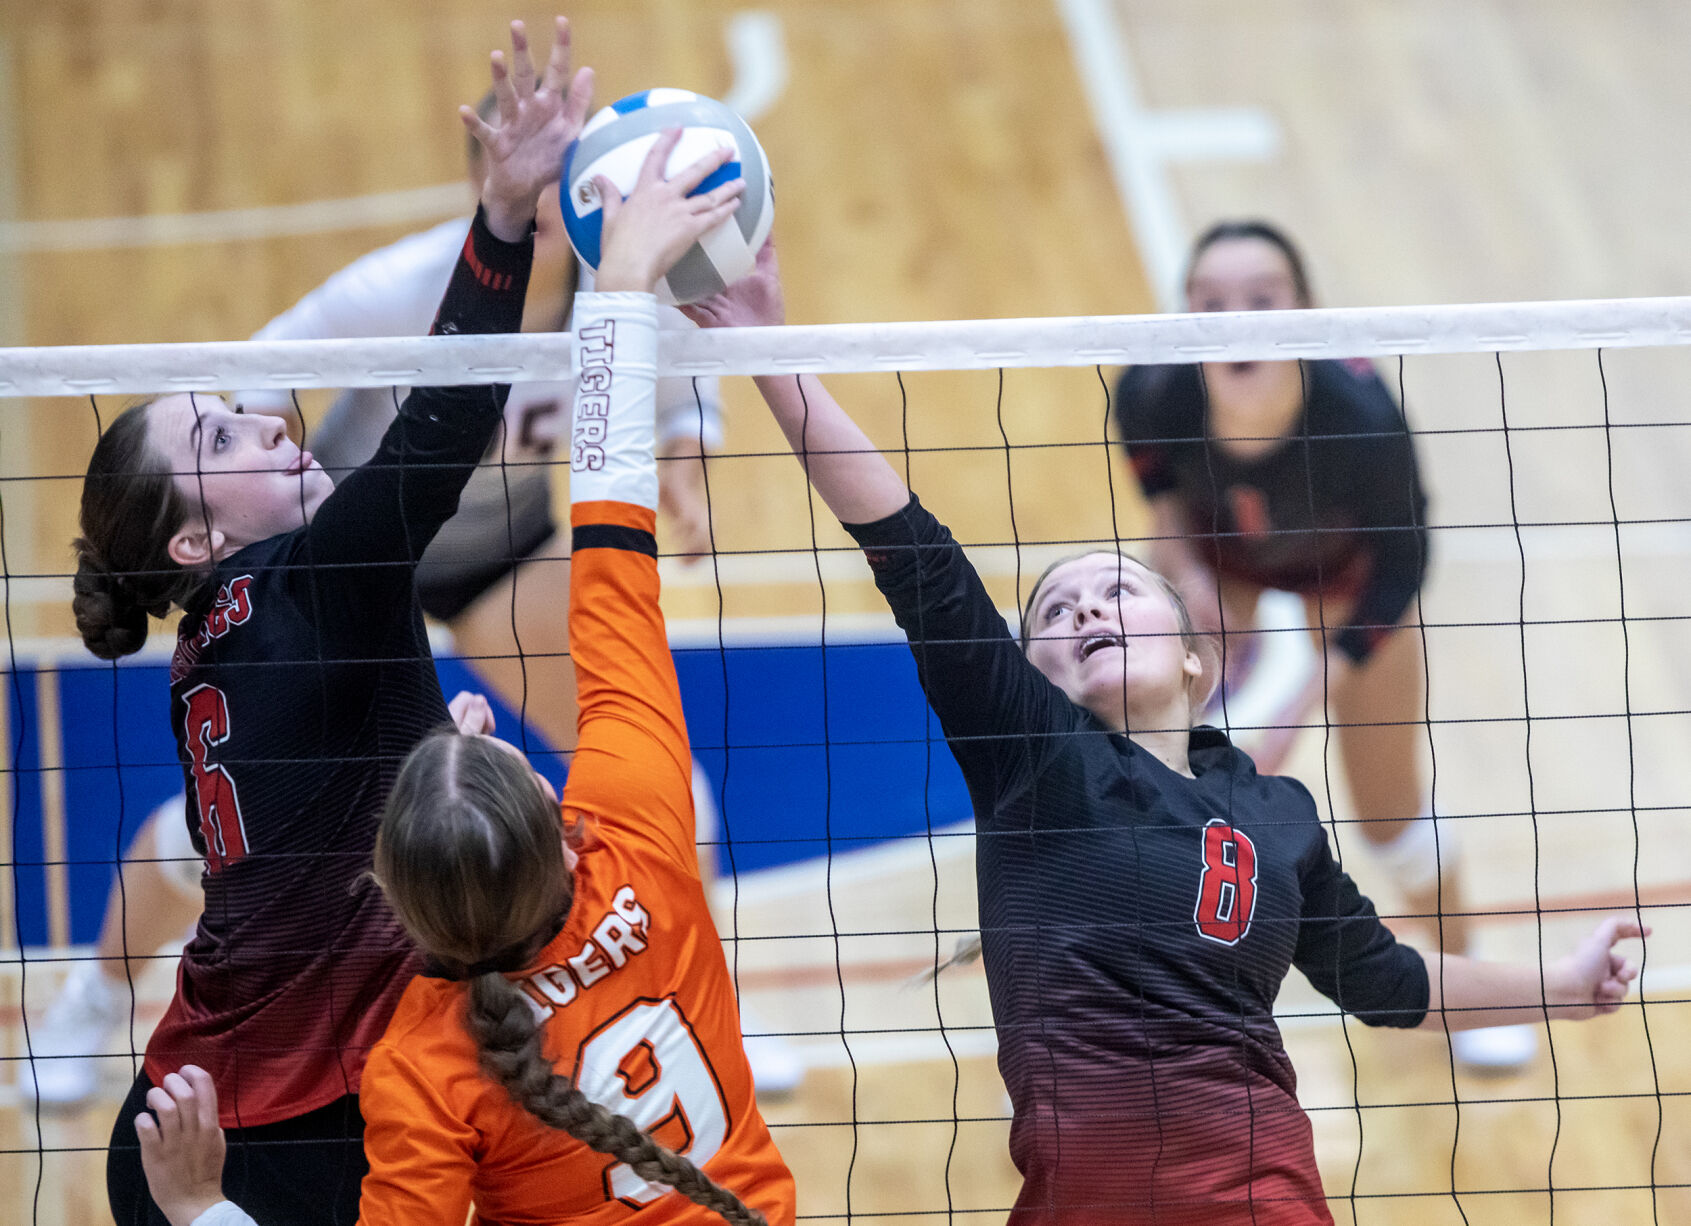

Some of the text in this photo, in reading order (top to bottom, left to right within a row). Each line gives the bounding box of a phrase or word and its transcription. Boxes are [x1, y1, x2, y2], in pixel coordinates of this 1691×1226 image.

[572, 318, 616, 473] TIGERS
[181, 682, 251, 876] 6
[518, 883, 652, 1028] IGERS
[1193, 817, 1259, 947] 8
[569, 991, 732, 1211] 9
